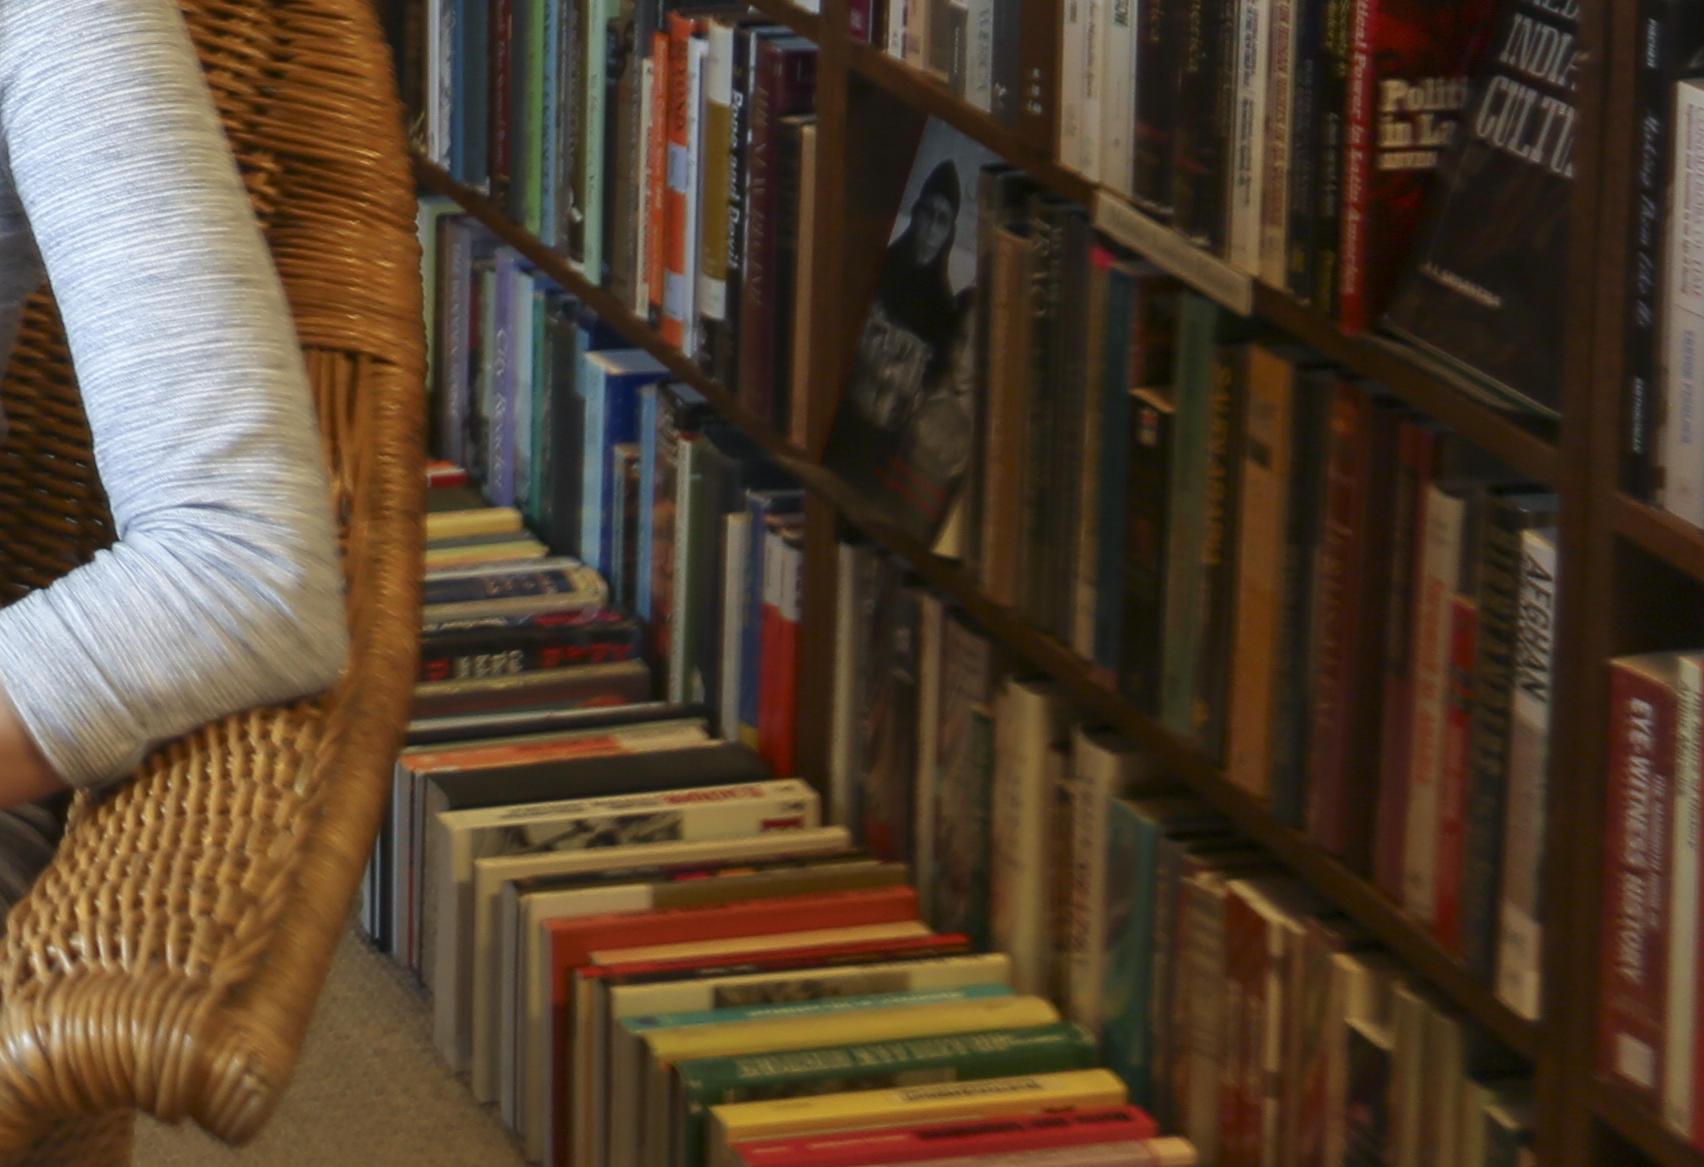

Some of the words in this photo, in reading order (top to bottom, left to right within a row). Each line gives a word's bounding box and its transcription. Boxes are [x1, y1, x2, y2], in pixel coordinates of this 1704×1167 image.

[1276, 2, 1291, 22] ON
[1274, 23, 1291, 72] HUMAN
[1351, 51, 1368, 119] Power
[1350, 124, 1364, 143] in
[1380, 113, 1413, 147] in
[1347, 147, 1363, 202] Latin
[1343, 205, 1360, 294] America
[1521, 550, 1555, 704] AFGHAN
[1623, 697, 1656, 871] EYE-WITNESS
[1616, 873, 1648, 986] HISTORY
